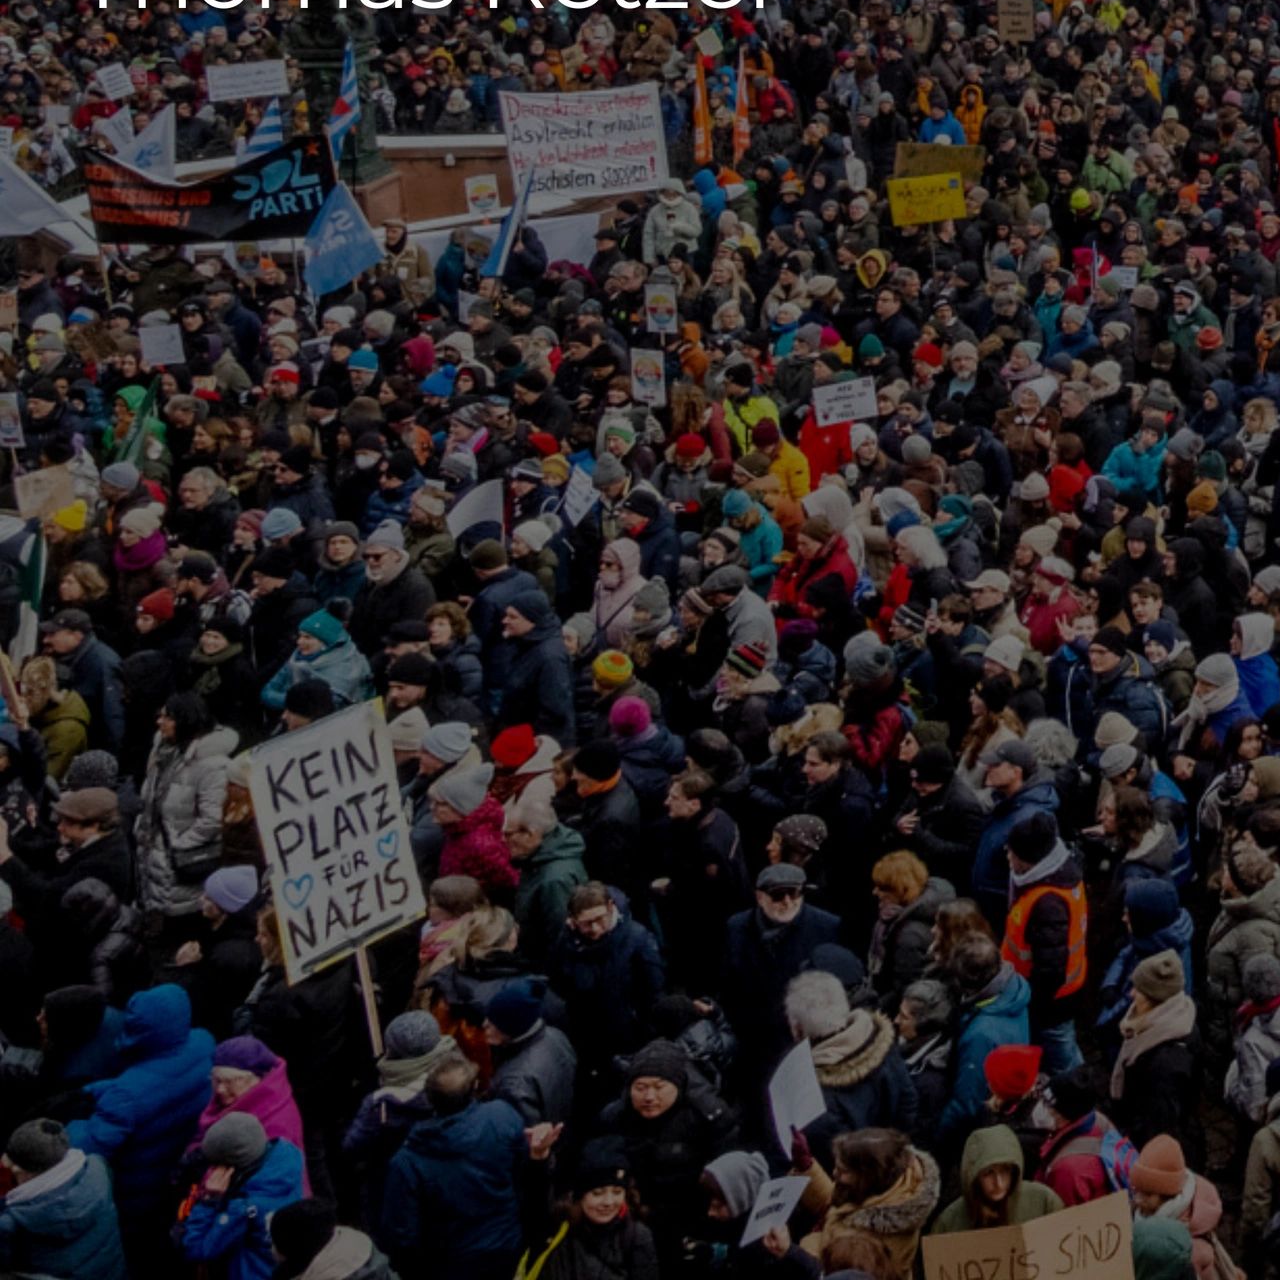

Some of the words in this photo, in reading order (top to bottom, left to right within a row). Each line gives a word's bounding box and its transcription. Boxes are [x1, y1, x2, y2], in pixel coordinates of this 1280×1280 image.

[266, 729, 380, 812] KEIN
[273, 783, 397, 873] PLATZ
[323, 850, 369, 886] FÜR
[287, 857, 409, 958] NAZIS
